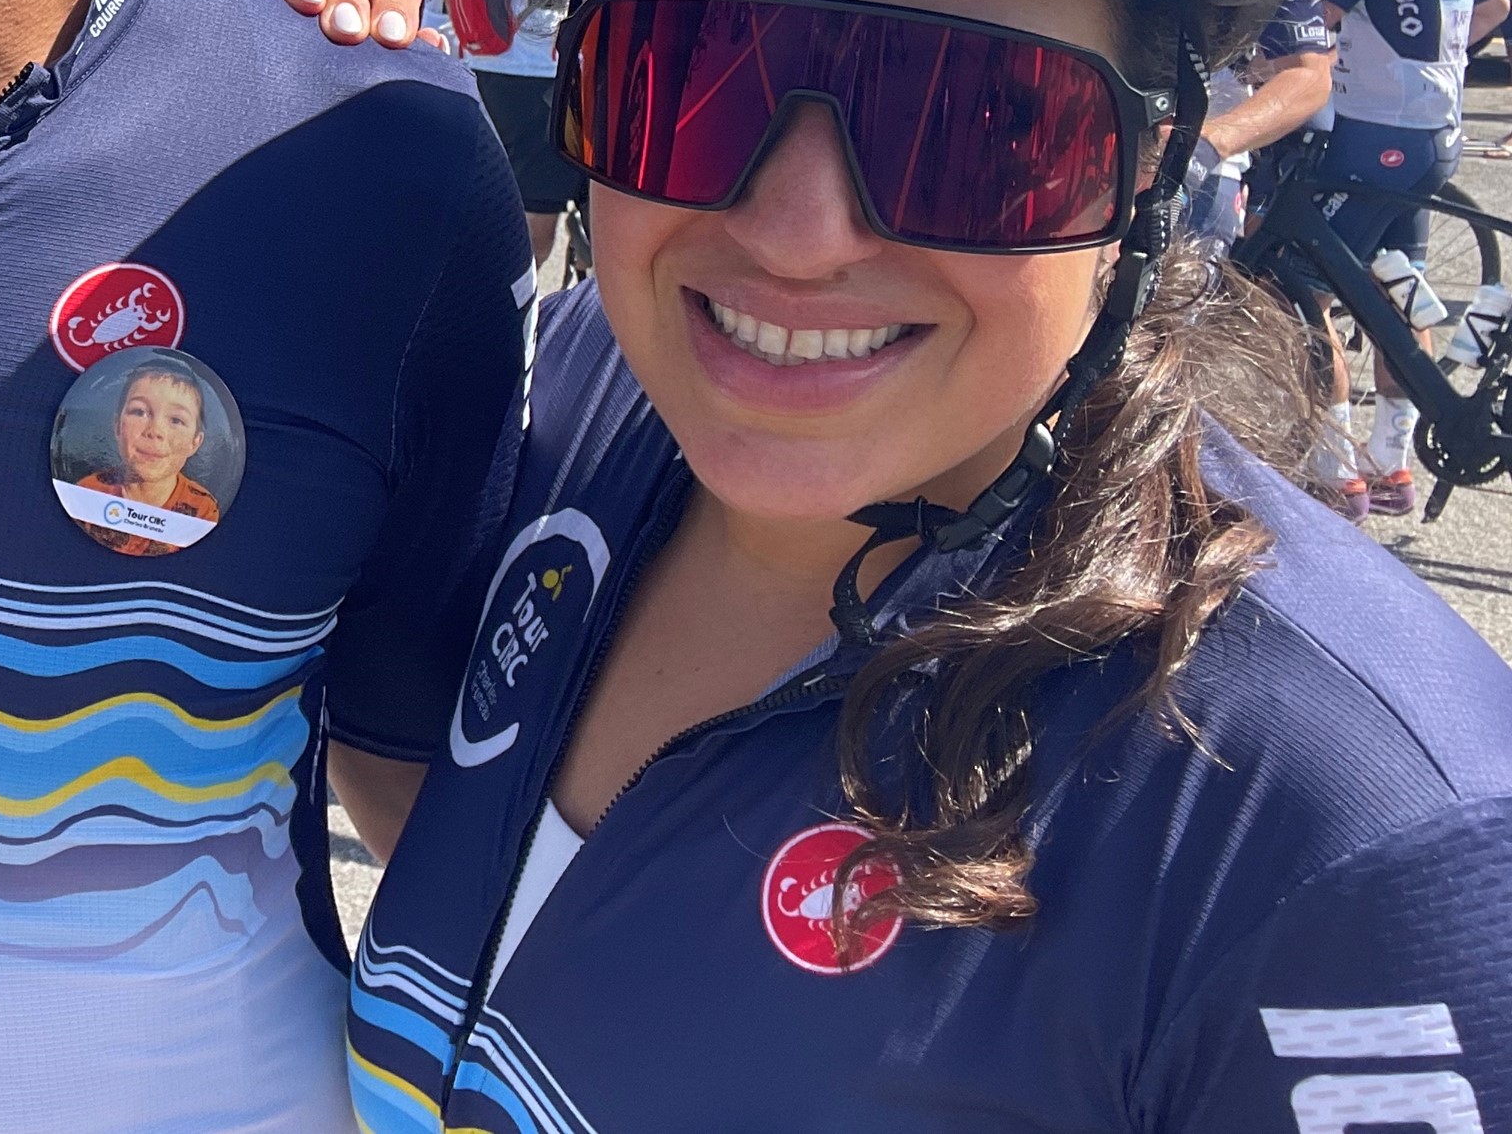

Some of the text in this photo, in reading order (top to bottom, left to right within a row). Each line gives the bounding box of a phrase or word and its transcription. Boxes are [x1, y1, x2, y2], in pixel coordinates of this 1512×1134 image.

[127, 507, 148, 522] Tour
[512, 571, 550, 653] Tour
[491, 622, 529, 688] CIBC
